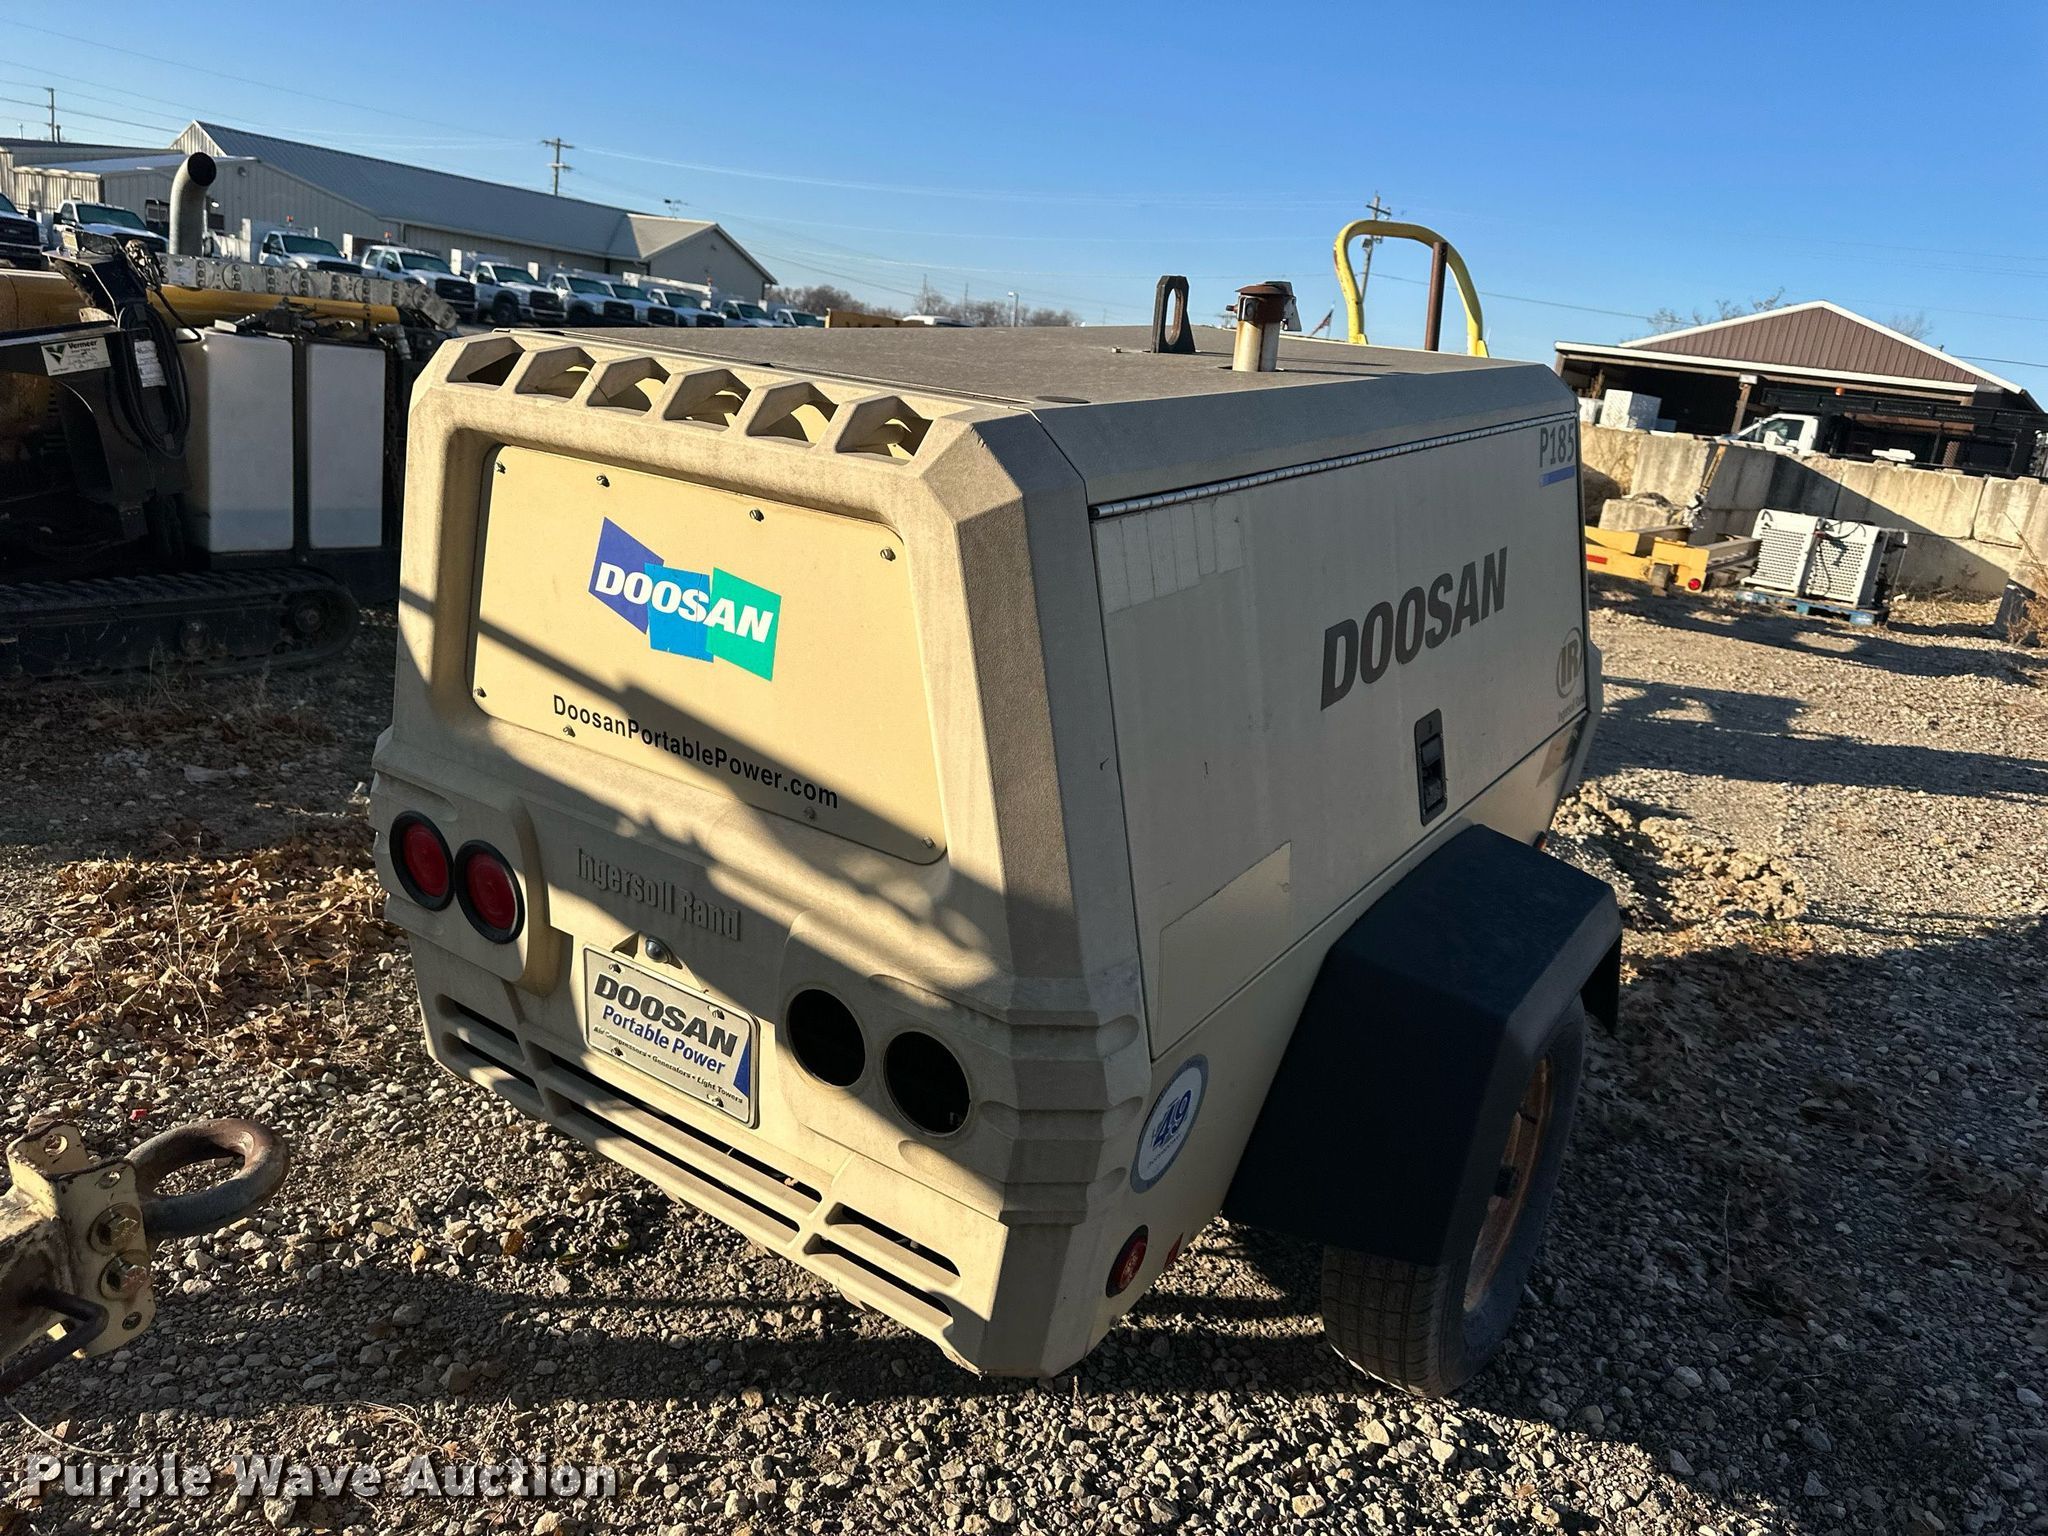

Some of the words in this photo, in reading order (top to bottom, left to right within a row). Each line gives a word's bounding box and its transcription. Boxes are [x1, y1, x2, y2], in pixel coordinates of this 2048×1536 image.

[1539, 423, 1575, 468] P185
[594, 561, 774, 643] DOOSAN
[1320, 546, 1507, 712] DOOSAN
[553, 695, 838, 808] DoosanPortablePower.com
[577, 848, 675, 914] Ingersoll
[679, 888, 741, 941] Rand
[594, 973, 738, 1057] DOOSAN
[602, 1005, 670, 1049] Portable
[671, 1037, 726, 1075] Power
[652, 1055, 691, 1079] Generators
[697, 1076, 716, 1091] Light
[717, 1085, 743, 1104] Towers
[1152, 1089, 1192, 1148] 49
